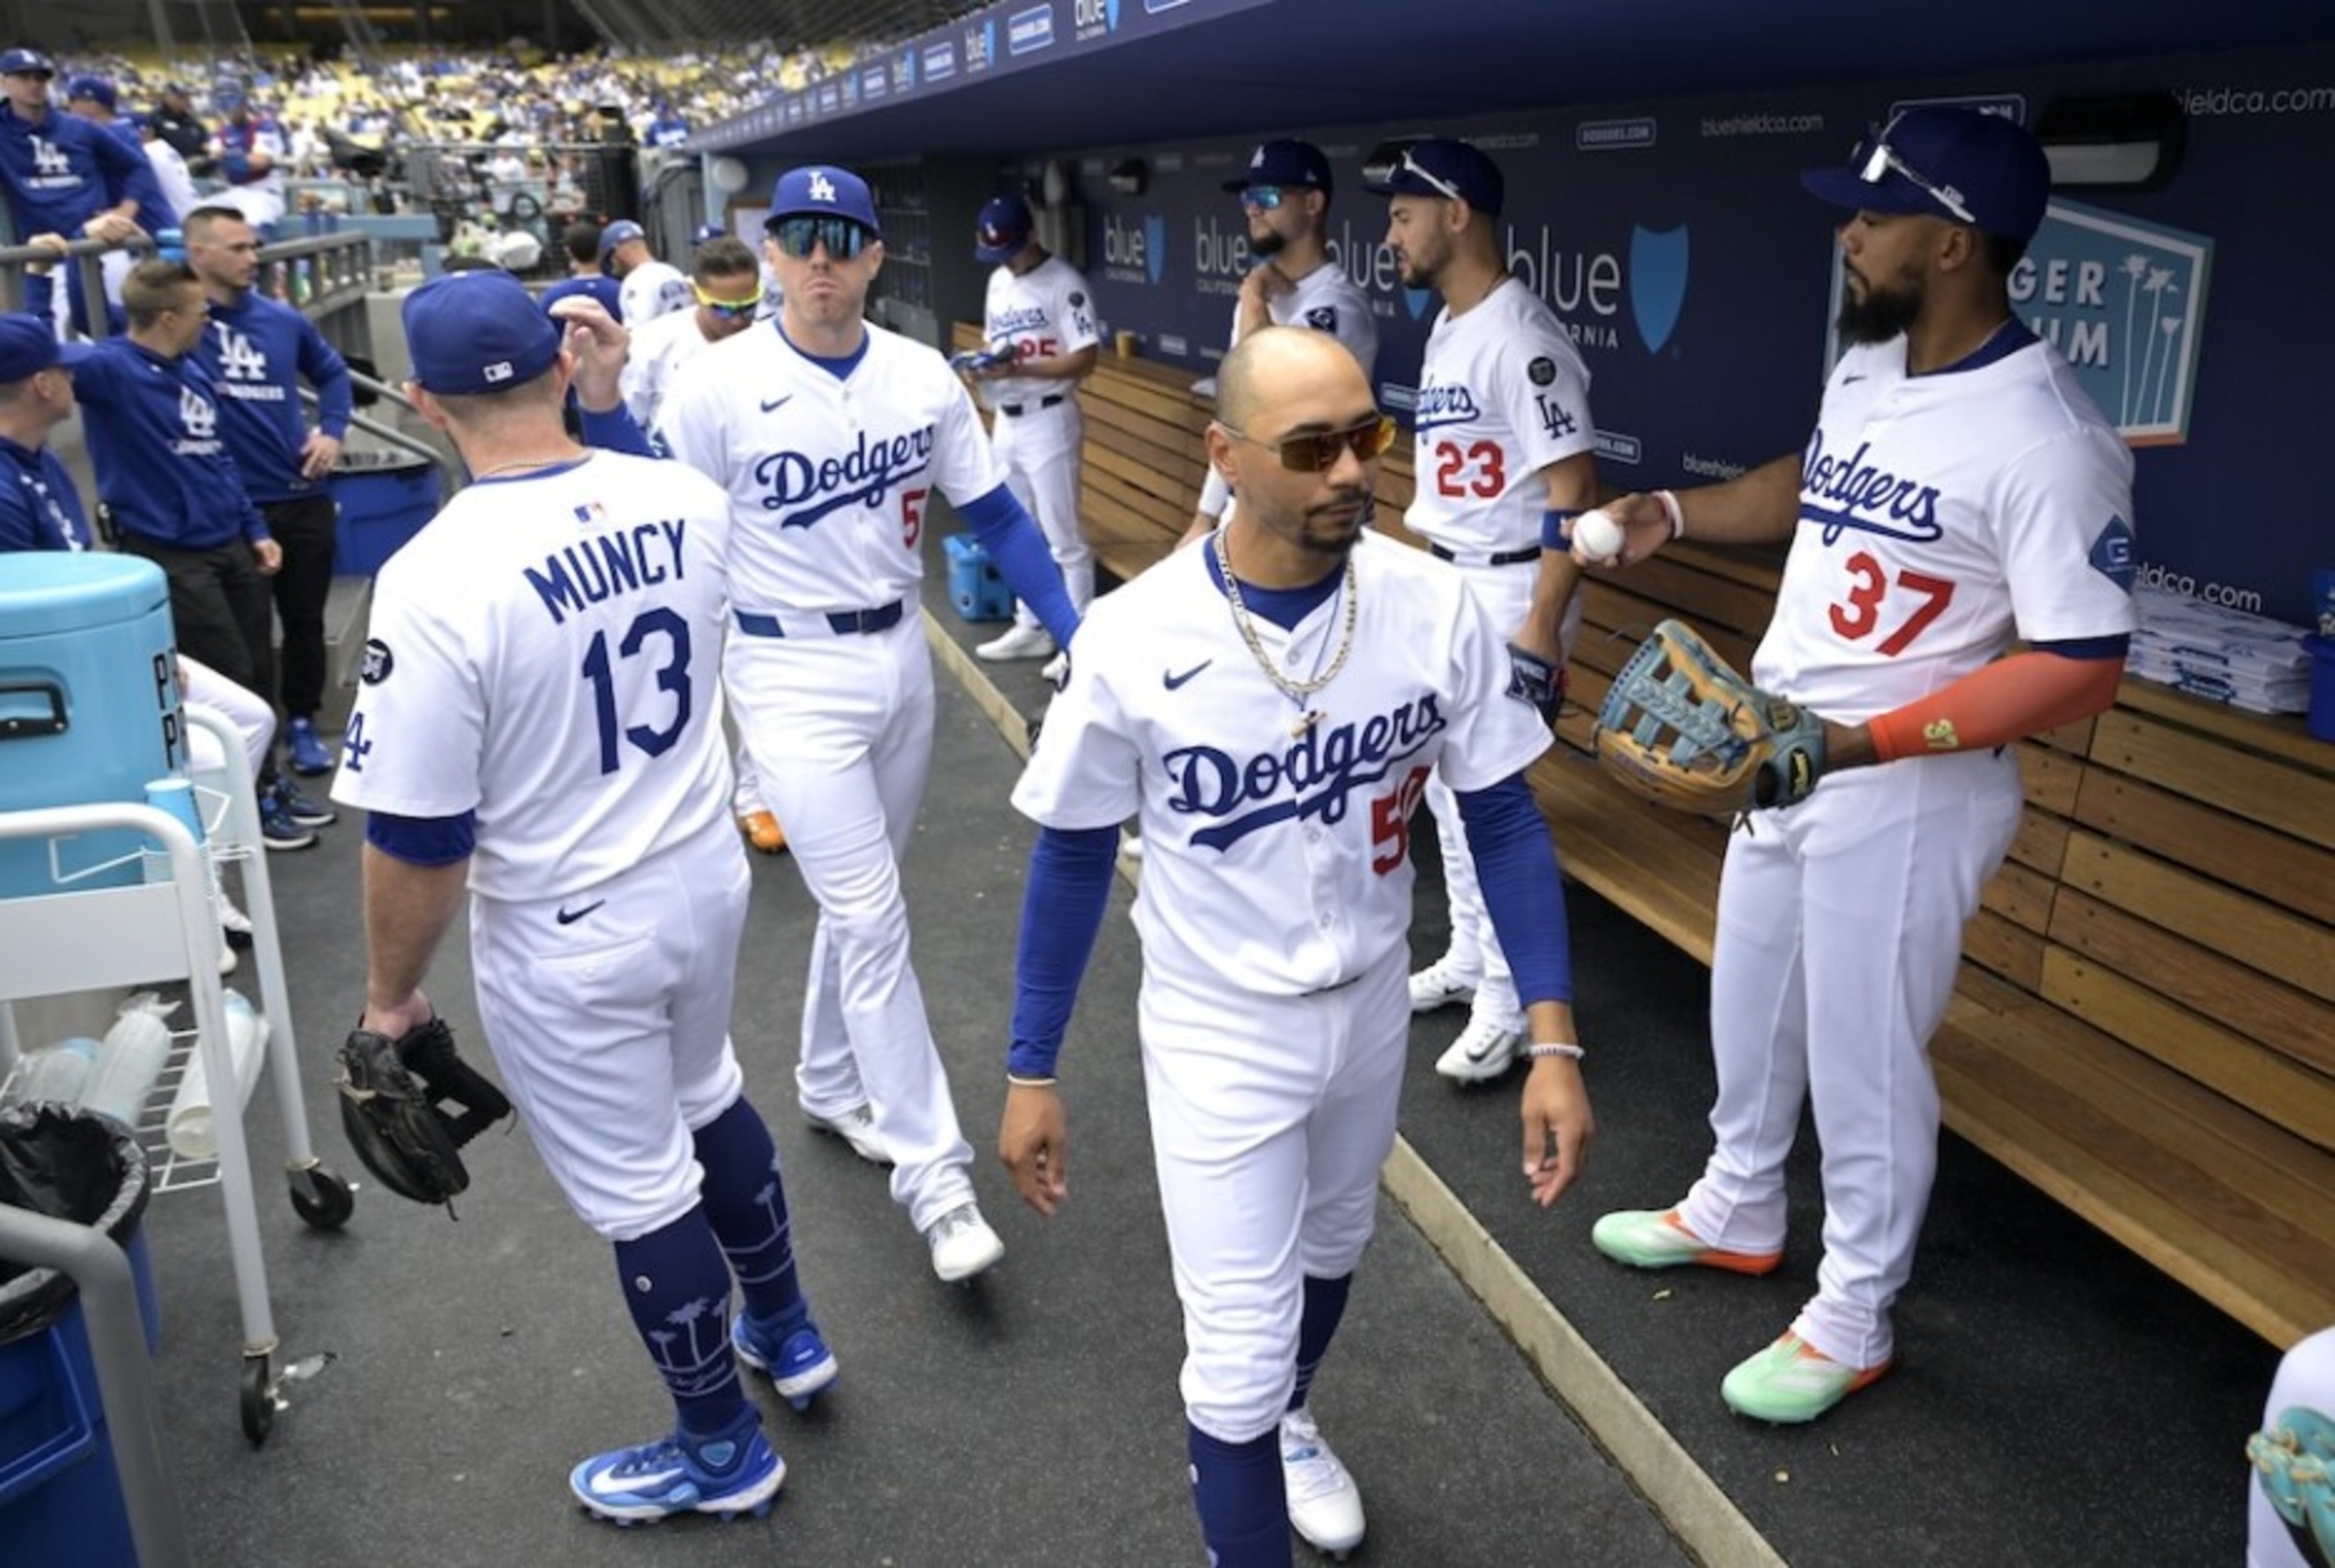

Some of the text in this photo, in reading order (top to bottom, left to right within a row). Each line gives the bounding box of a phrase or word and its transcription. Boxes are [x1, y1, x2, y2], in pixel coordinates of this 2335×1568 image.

[2180, 86, 2335, 116] ieldca.com
[808, 172, 836, 202] LA
[1104, 215, 1144, 265] blue
[1196, 216, 1247, 275] blue
[1507, 225, 1620, 315] blue
[2007, 257, 2105, 305] GER
[1535, 393, 1577, 439] LA
[1436, 439, 1505, 499] 23
[901, 488, 926, 549] 5
[523, 519, 685, 625] MUNCY
[1829, 551, 1954, 657] 37
[582, 606, 692, 776] 13
[1163, 693, 1448, 854] Dodgers
